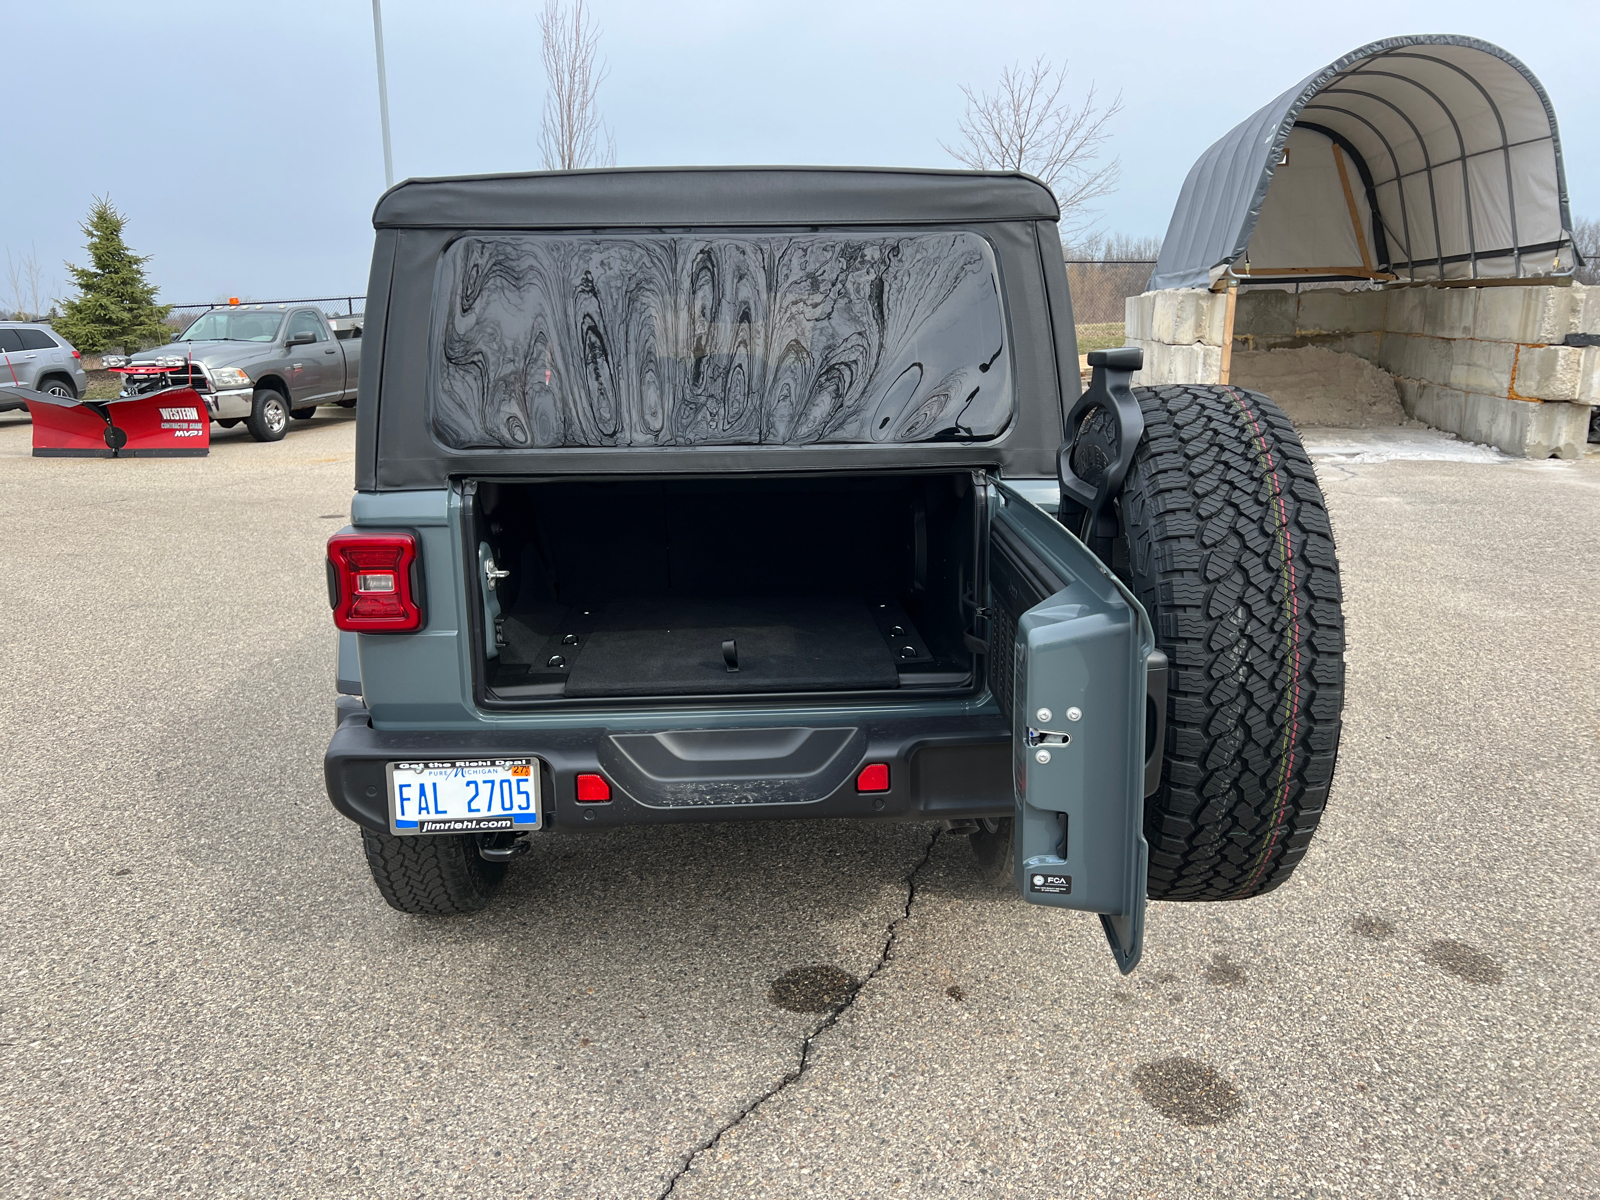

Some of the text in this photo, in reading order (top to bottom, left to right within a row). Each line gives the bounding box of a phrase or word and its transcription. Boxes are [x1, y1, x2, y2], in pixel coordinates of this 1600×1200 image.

[159, 407, 199, 420] WESTERN
[189, 422, 203, 430] GRADE
[446, 767, 498, 780] MICHIGAN
[513, 765, 526, 774] 27
[398, 778, 530, 816] FAL 2705
[422, 820, 511, 832] jimriehl.com
[1047, 876, 1067, 884] FCA
